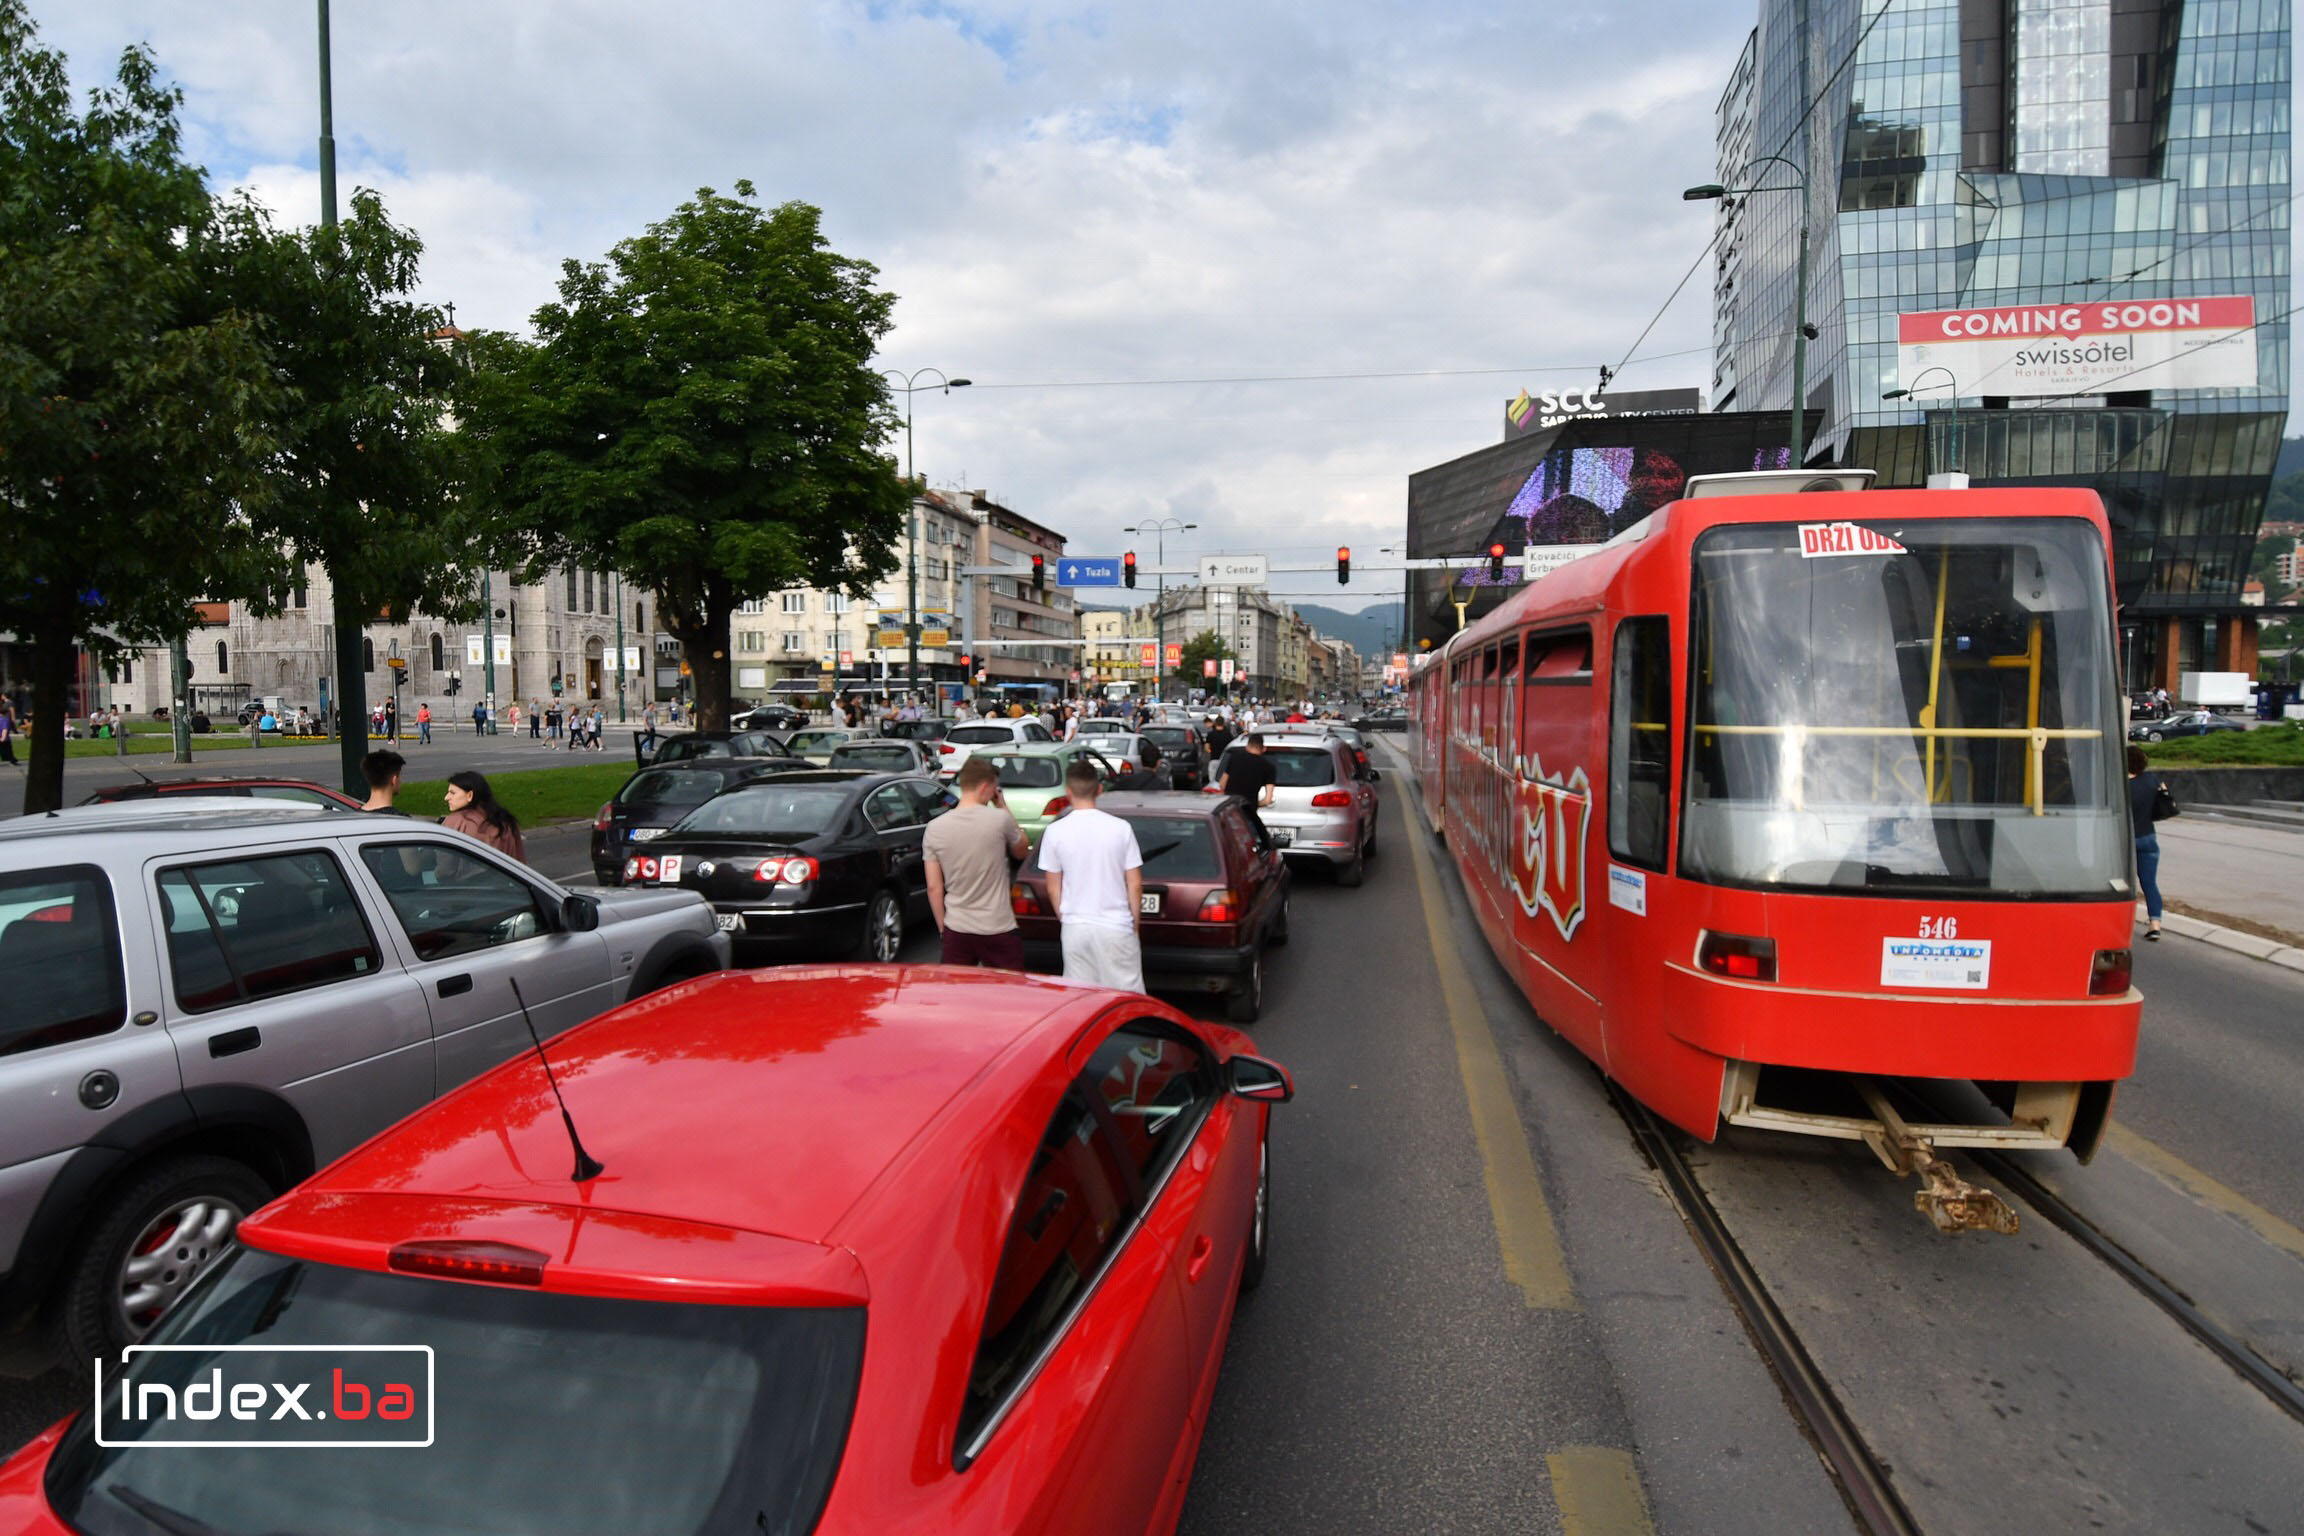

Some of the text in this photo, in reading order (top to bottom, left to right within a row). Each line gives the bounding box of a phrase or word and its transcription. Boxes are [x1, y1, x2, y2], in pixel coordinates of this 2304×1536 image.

[1942, 302, 2201, 337] COMING SOON
[2015, 334, 2134, 366] swissôtel
[2015, 366, 2057, 377] Hotels
[2083, 364, 2135, 375] Resorts
[1540, 386, 1606, 414] SCC
[1084, 567, 1111, 577] Tuzla
[664, 859, 678, 876] P
[717, 916, 733, 929] 82
[1918, 915, 1958, 939] 546
